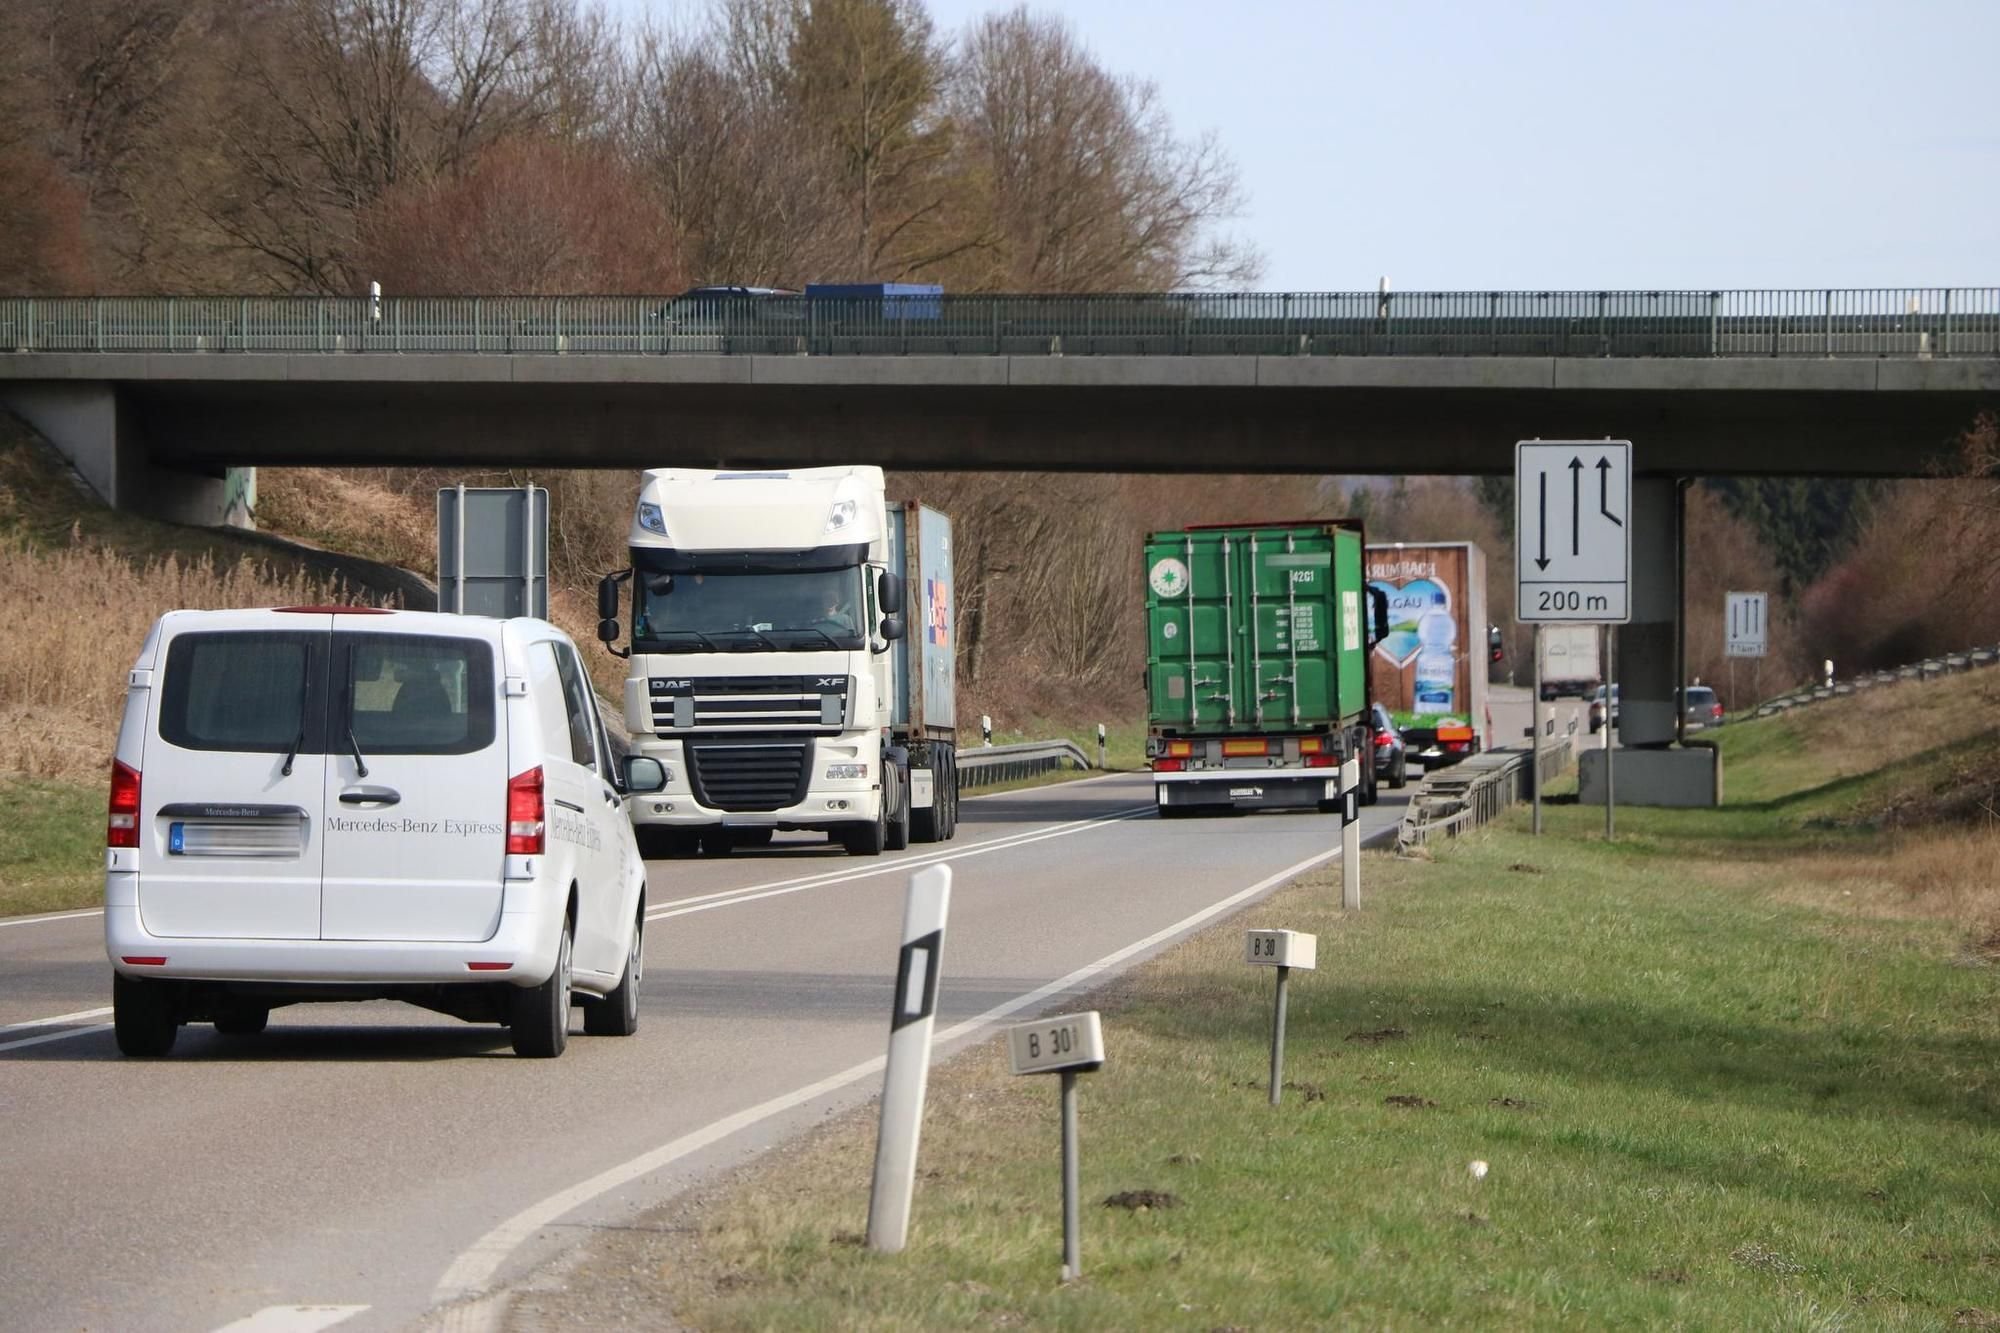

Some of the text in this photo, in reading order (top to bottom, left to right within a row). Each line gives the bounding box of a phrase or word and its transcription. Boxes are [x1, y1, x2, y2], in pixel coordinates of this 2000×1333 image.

[1538, 590, 1607, 611] 200 m
[651, 680, 691, 689] DAF
[815, 678, 845, 687] XF
[205, 807, 260, 817] Mercedes-Benz
[327, 817, 503, 837] Mercedes-Benz Express
[1254, 937, 1276, 956] B 30
[1028, 1032, 1041, 1059] B
[1049, 1027, 1072, 1055] 30
